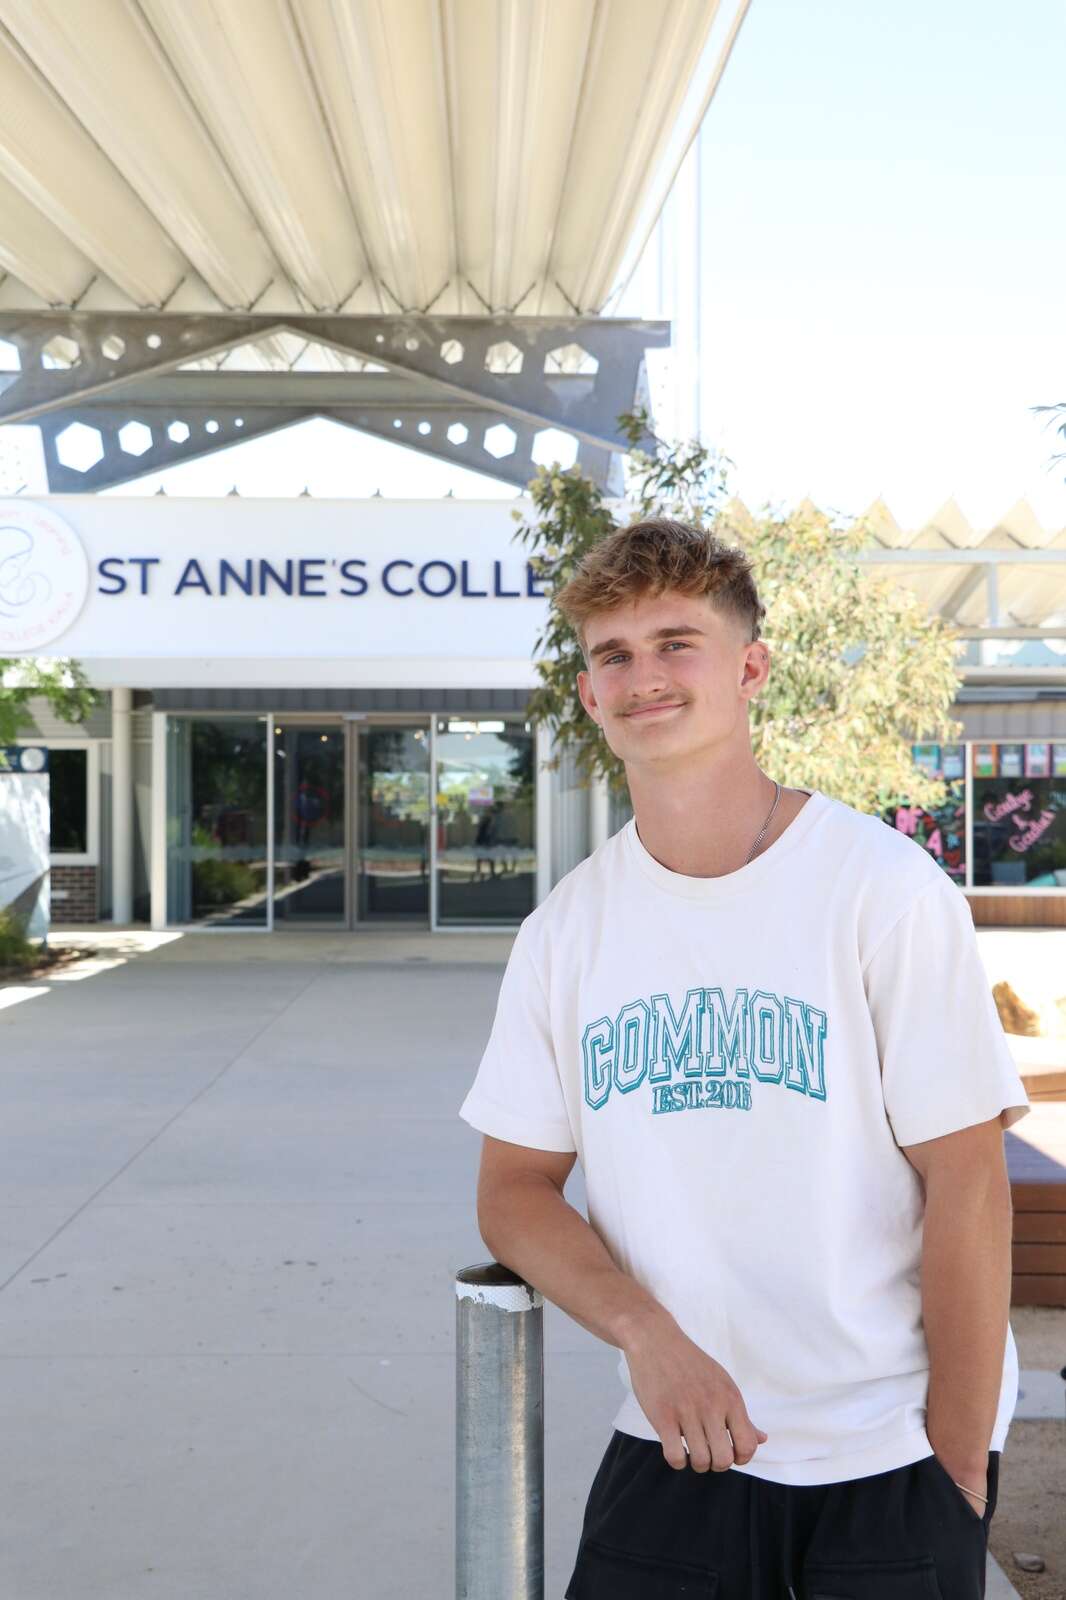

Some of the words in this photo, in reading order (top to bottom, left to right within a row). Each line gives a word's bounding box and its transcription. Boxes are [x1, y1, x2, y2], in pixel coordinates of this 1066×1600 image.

[97, 558, 160, 595] ST
[174, 558, 369, 597] ANNE'S
[582, 988, 828, 1110] COMMON
